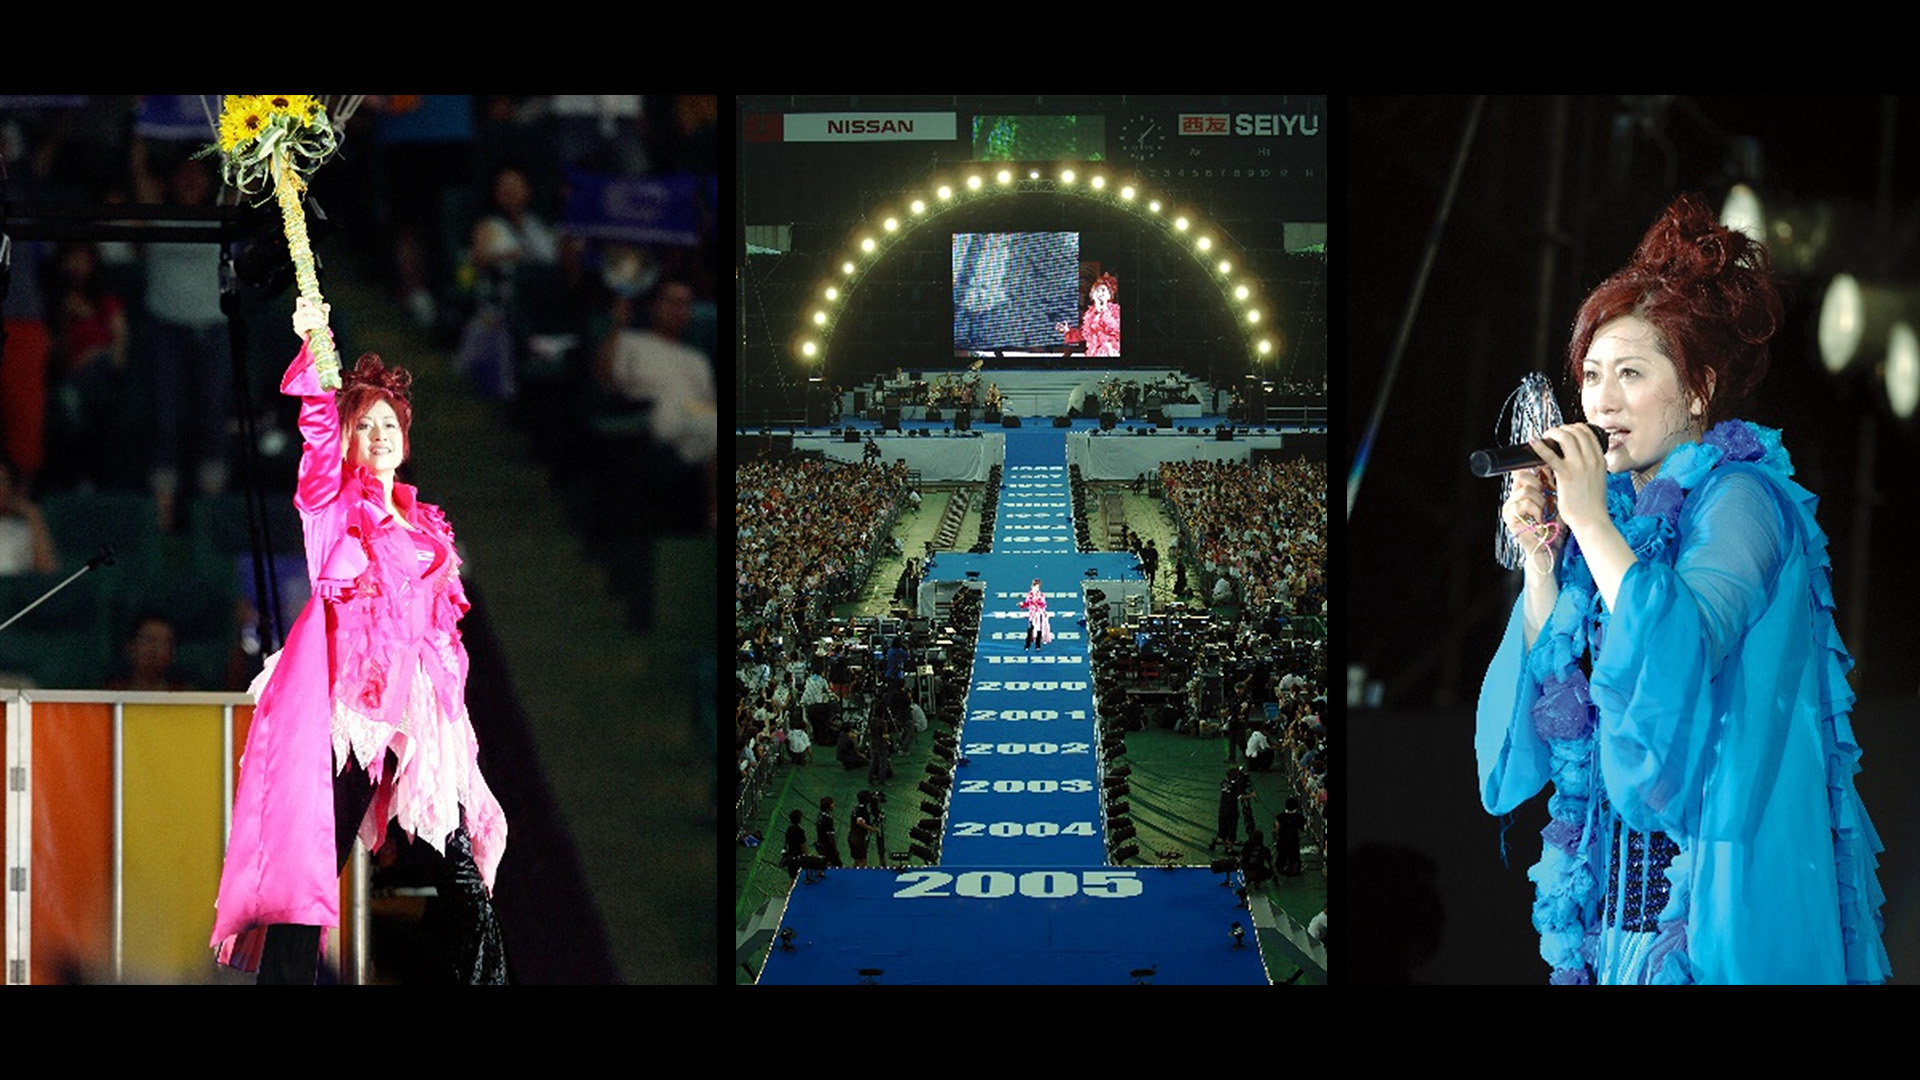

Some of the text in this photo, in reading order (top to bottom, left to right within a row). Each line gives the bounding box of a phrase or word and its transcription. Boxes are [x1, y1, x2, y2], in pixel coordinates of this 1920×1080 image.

[827, 119, 914, 134] NISSAN
[1182, 117, 1227, 133] 西友
[1235, 113, 1319, 136] SEIYU
[976, 681, 1088, 691] 2000
[970, 709, 1086, 721] 2001
[965, 742, 1090, 755] 2002
[958, 779, 1094, 793] 2003
[952, 822, 1097, 837] 2004
[893, 871, 1143, 898] 2005
